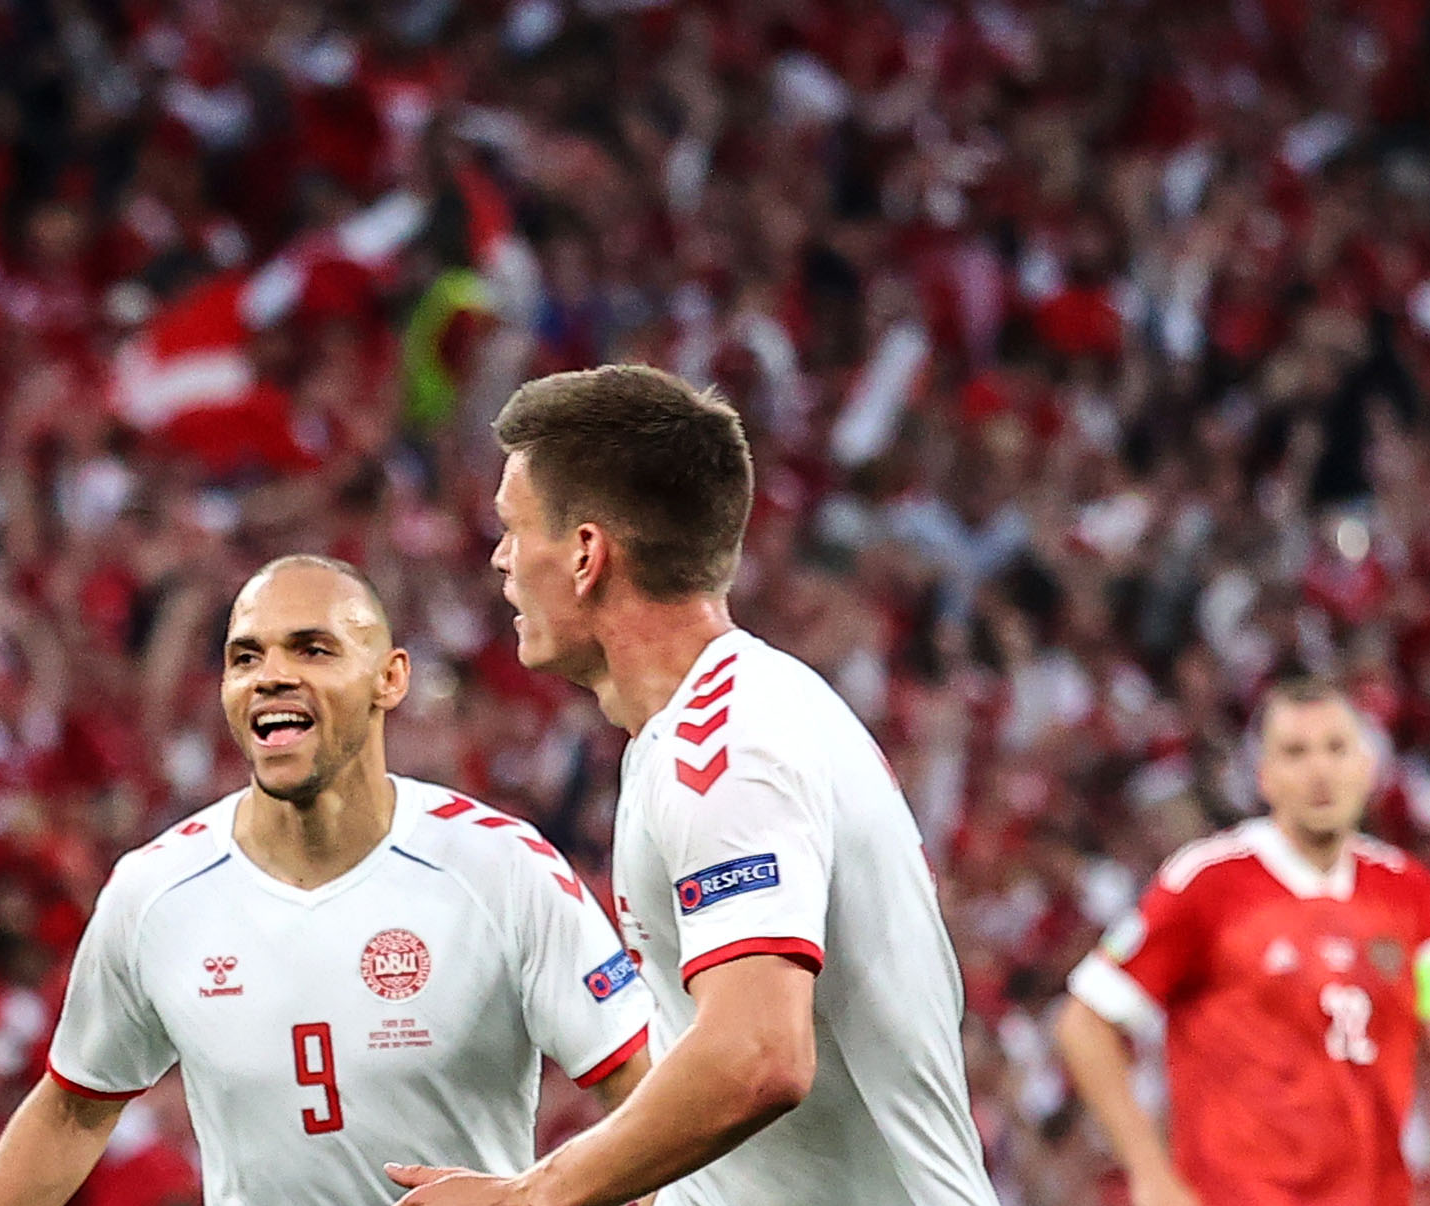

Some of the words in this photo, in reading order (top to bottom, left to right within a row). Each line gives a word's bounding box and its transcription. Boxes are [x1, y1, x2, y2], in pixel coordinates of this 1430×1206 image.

[701, 862, 778, 895] RESPECT
[374, 952, 418, 976] DBU
[292, 1022, 344, 1135] 9
